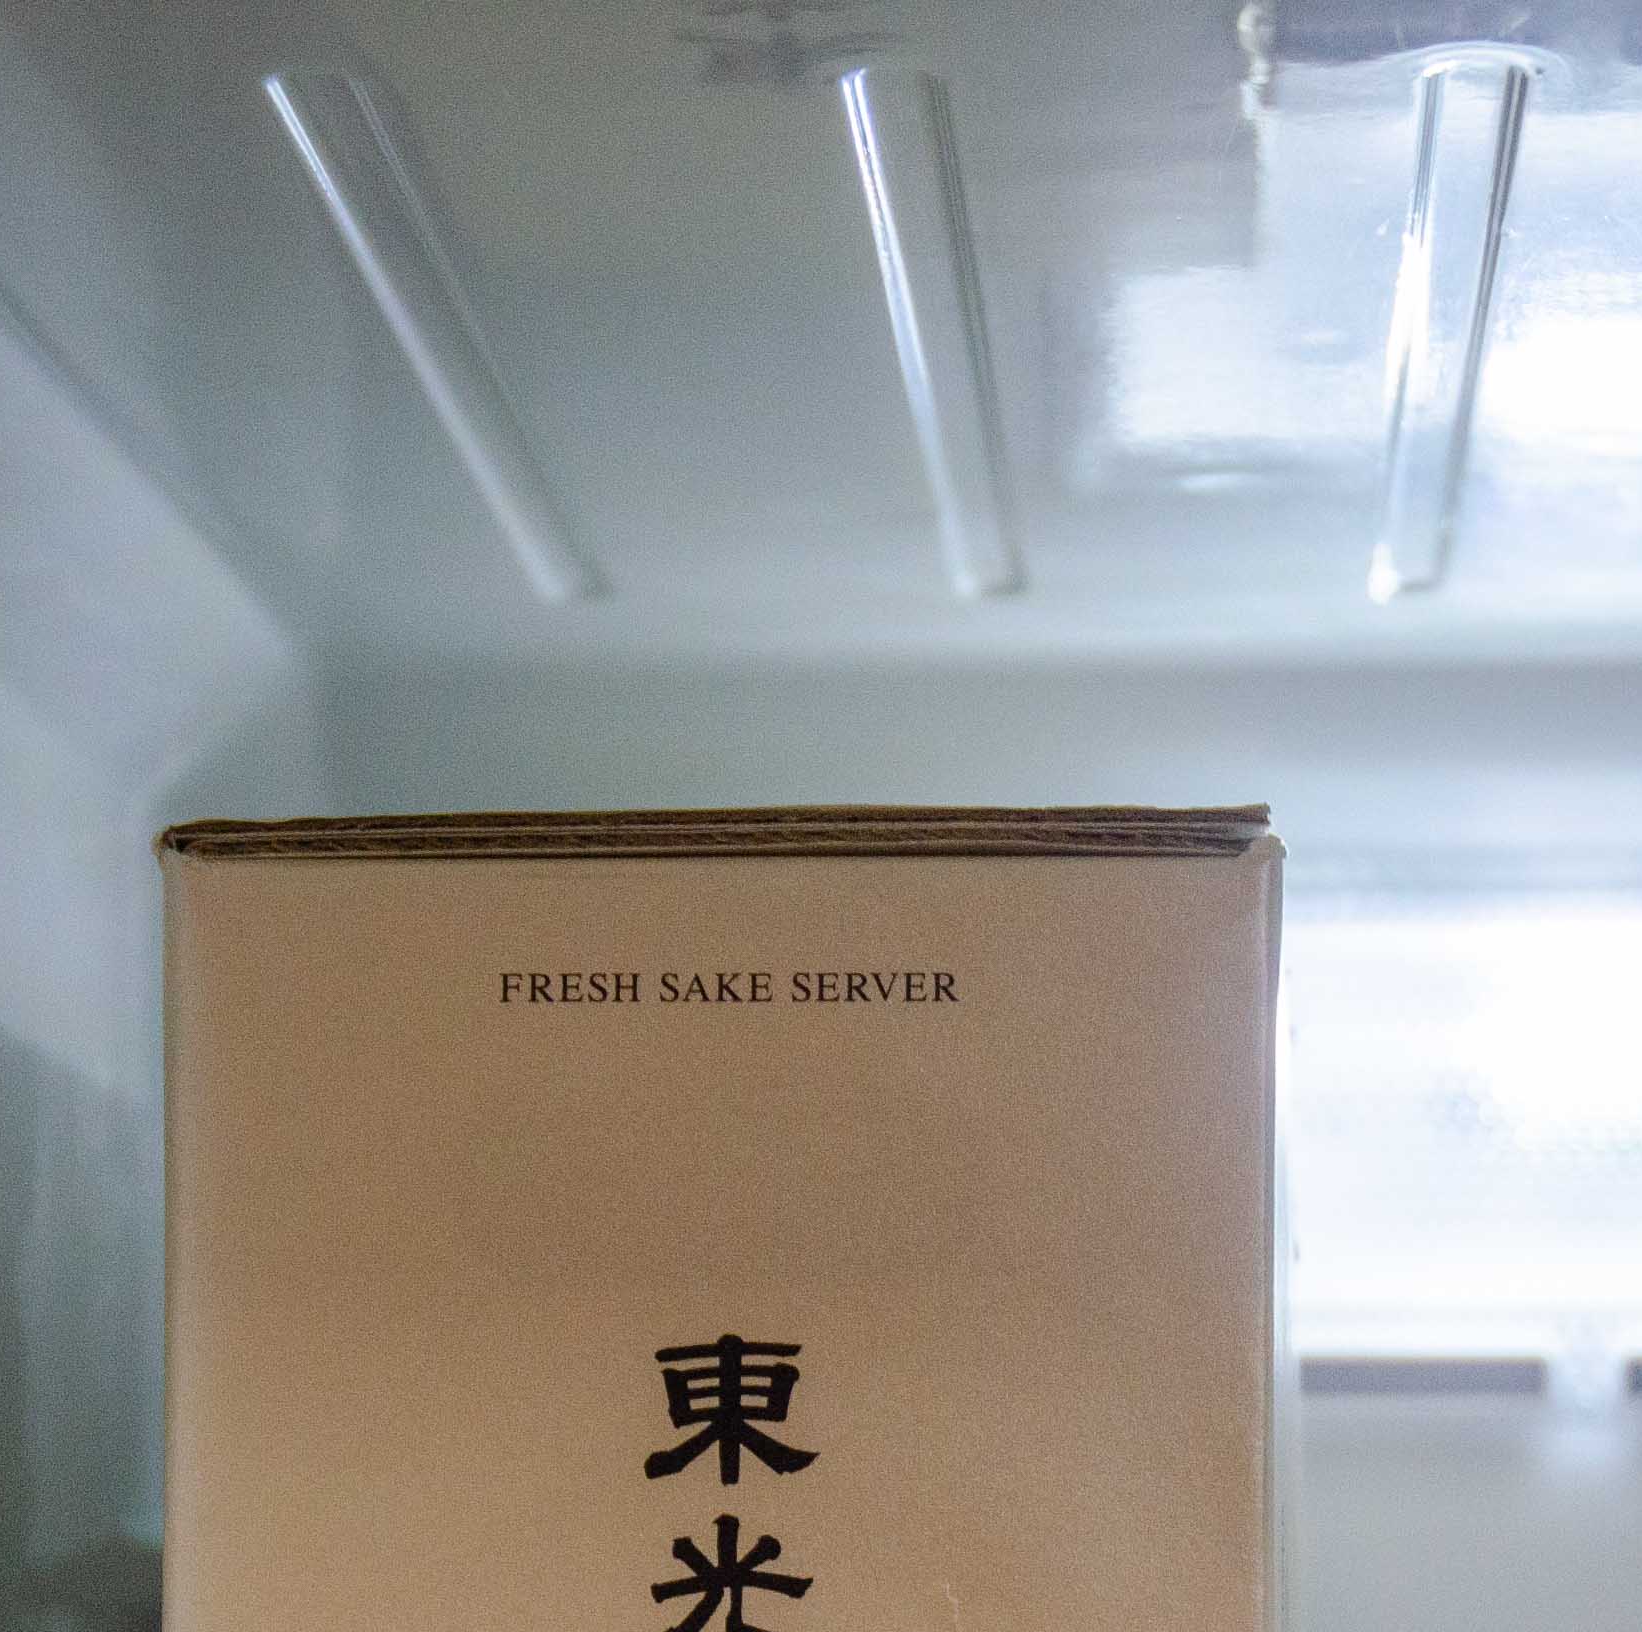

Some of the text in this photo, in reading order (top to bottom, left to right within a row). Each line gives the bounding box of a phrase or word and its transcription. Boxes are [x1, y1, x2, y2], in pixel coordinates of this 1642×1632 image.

[498, 972, 960, 1003] FRESH SAKE SERVER
